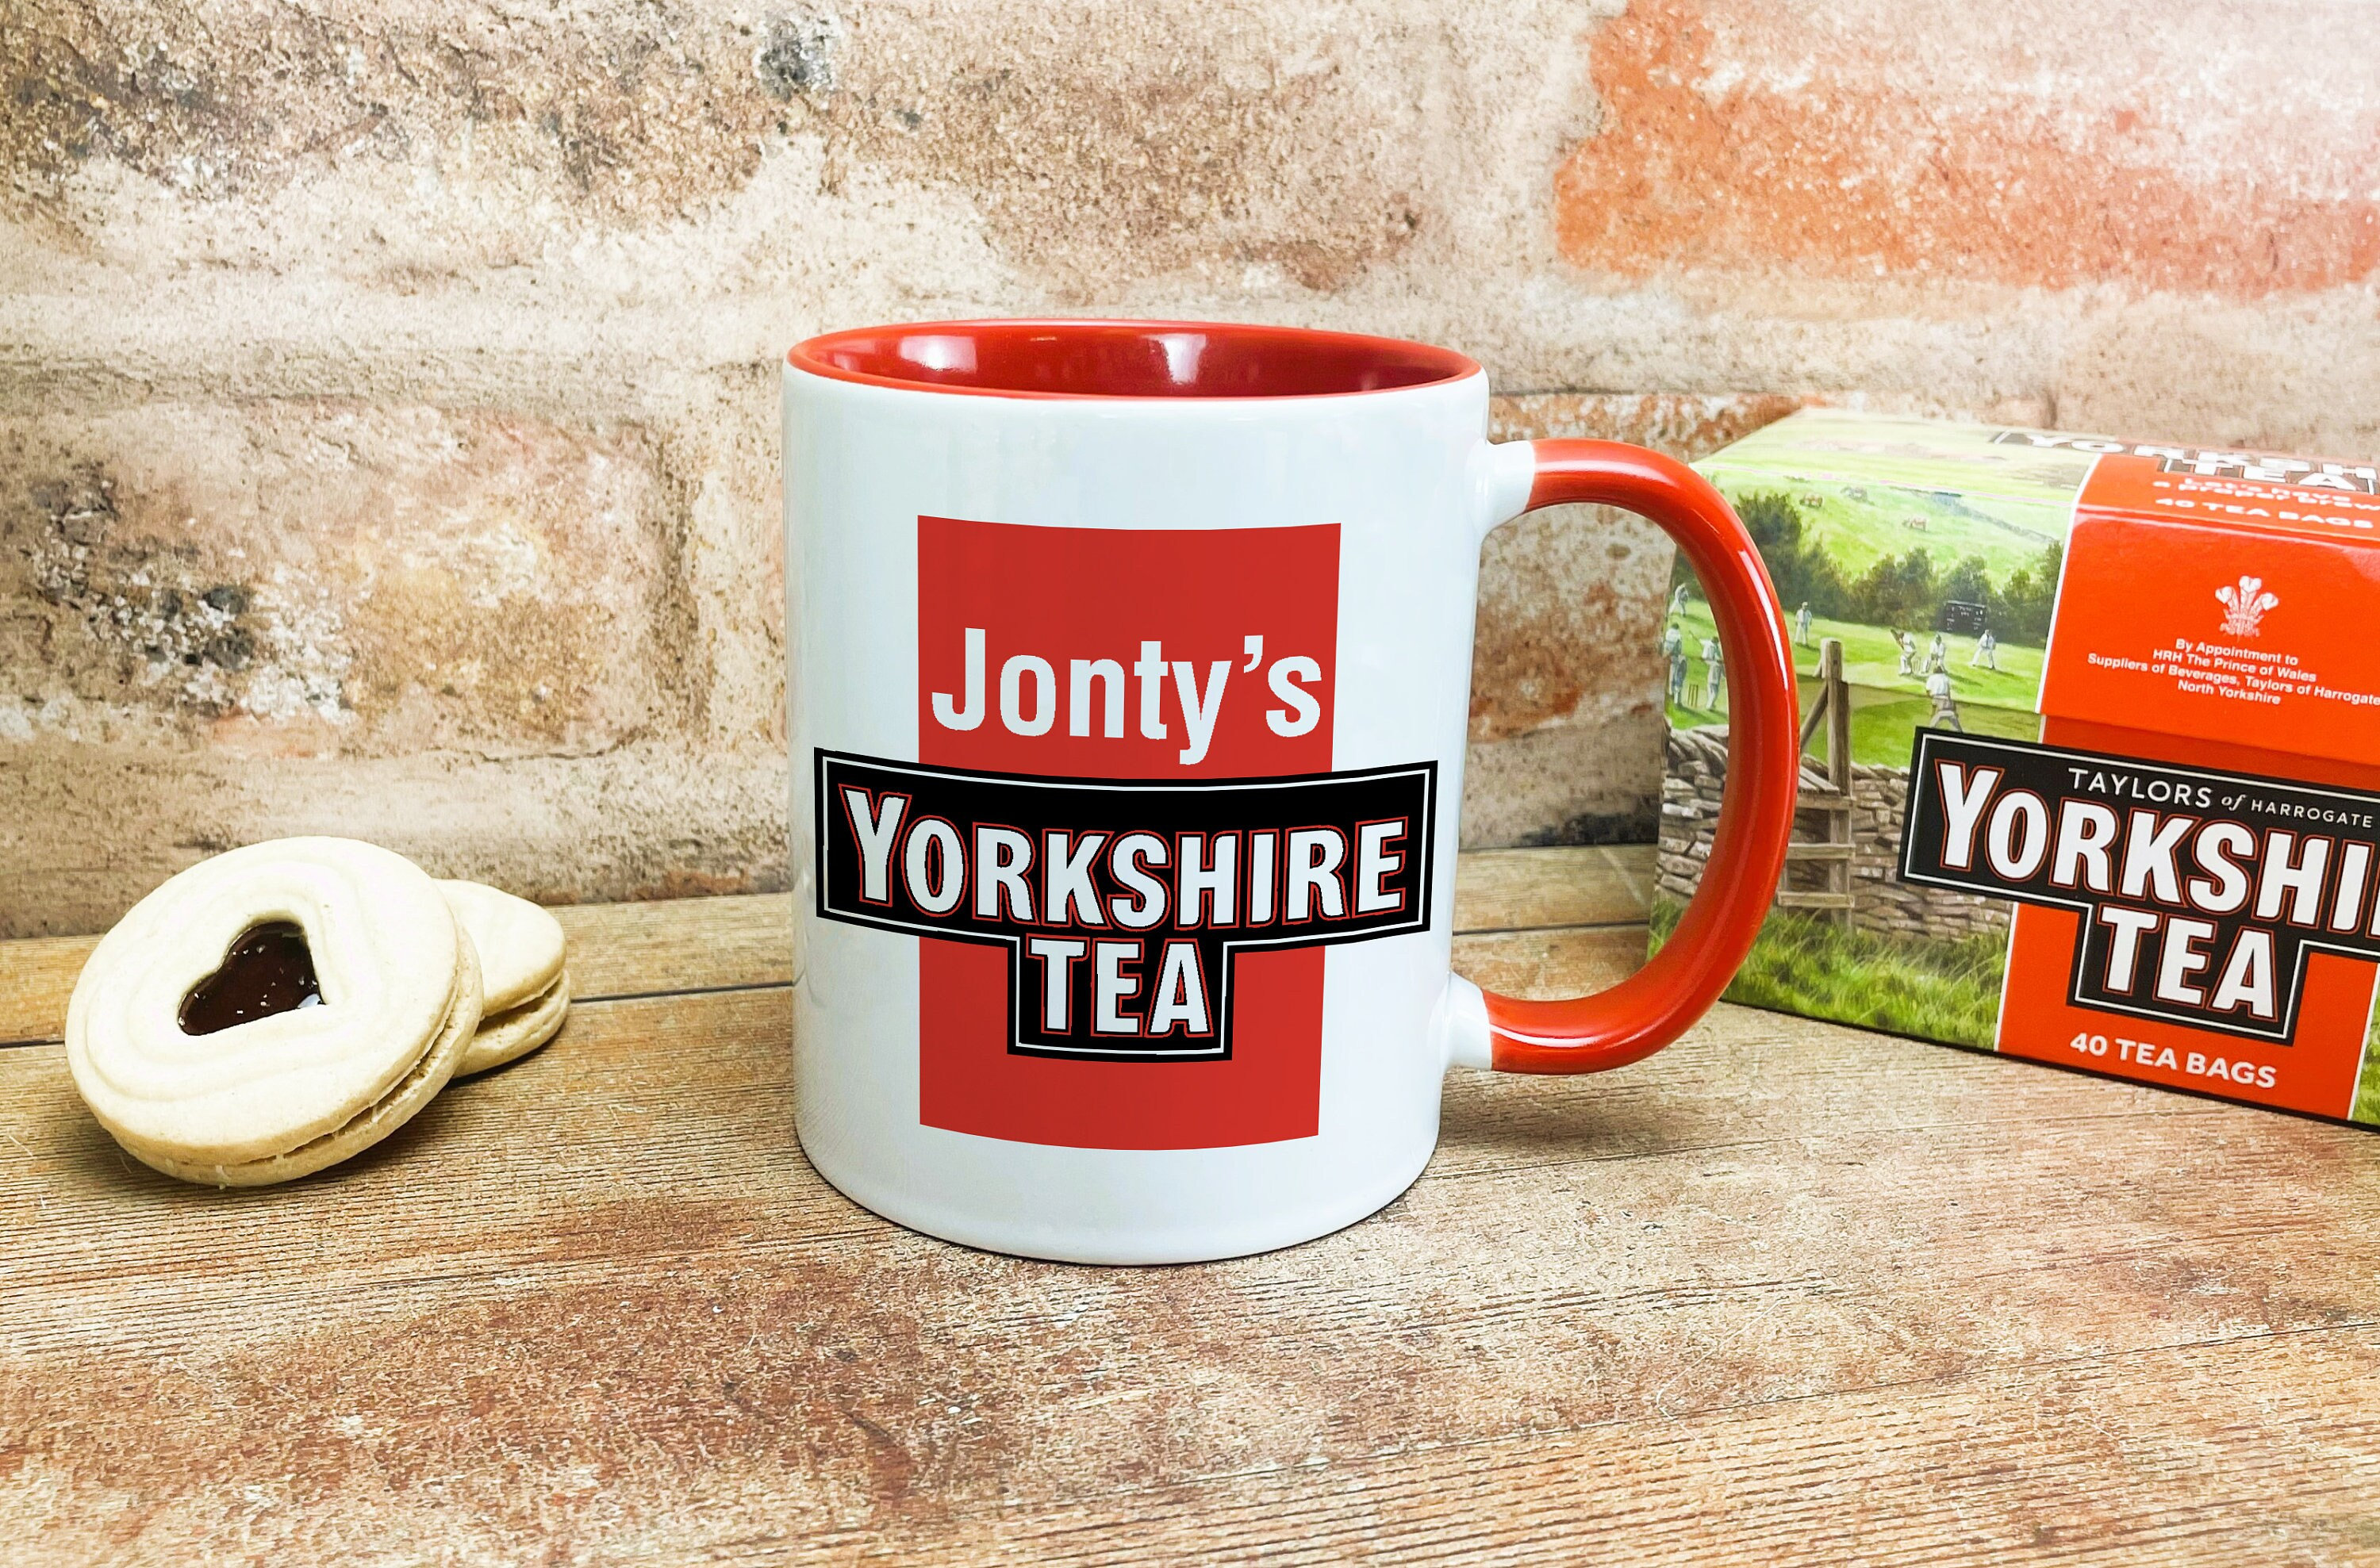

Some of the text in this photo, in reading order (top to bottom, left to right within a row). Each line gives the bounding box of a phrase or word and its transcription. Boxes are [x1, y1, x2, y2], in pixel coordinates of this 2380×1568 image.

[2155, 497, 2374, 529] 40 TEA BAGS
[2087, 652, 2148, 672] Suppliers
[2152, 663, 2165, 674] of
[2245, 675, 2294, 693] Taylors
[2297, 684, 2311, 695] of
[2314, 685, 2380, 706] Harrogate
[2152, 649, 2317, 683] HRH The Prince of Wales
[2175, 638, 2299, 665] By Appointment to
[931, 627, 1322, 765] Jonty's
[2178, 679, 2282, 705] North Yorkshire
[2068, 767, 2374, 829] TAYLORS of HARROGATE
[841, 786, 1406, 931] YORKSHIRE
[1937, 761, 2380, 936] YORKSHI
[1024, 937, 1211, 1036] TEA
[2099, 906, 2276, 1020] TEA
[2070, 1032, 2277, 1089] 40 TEA BAGS
